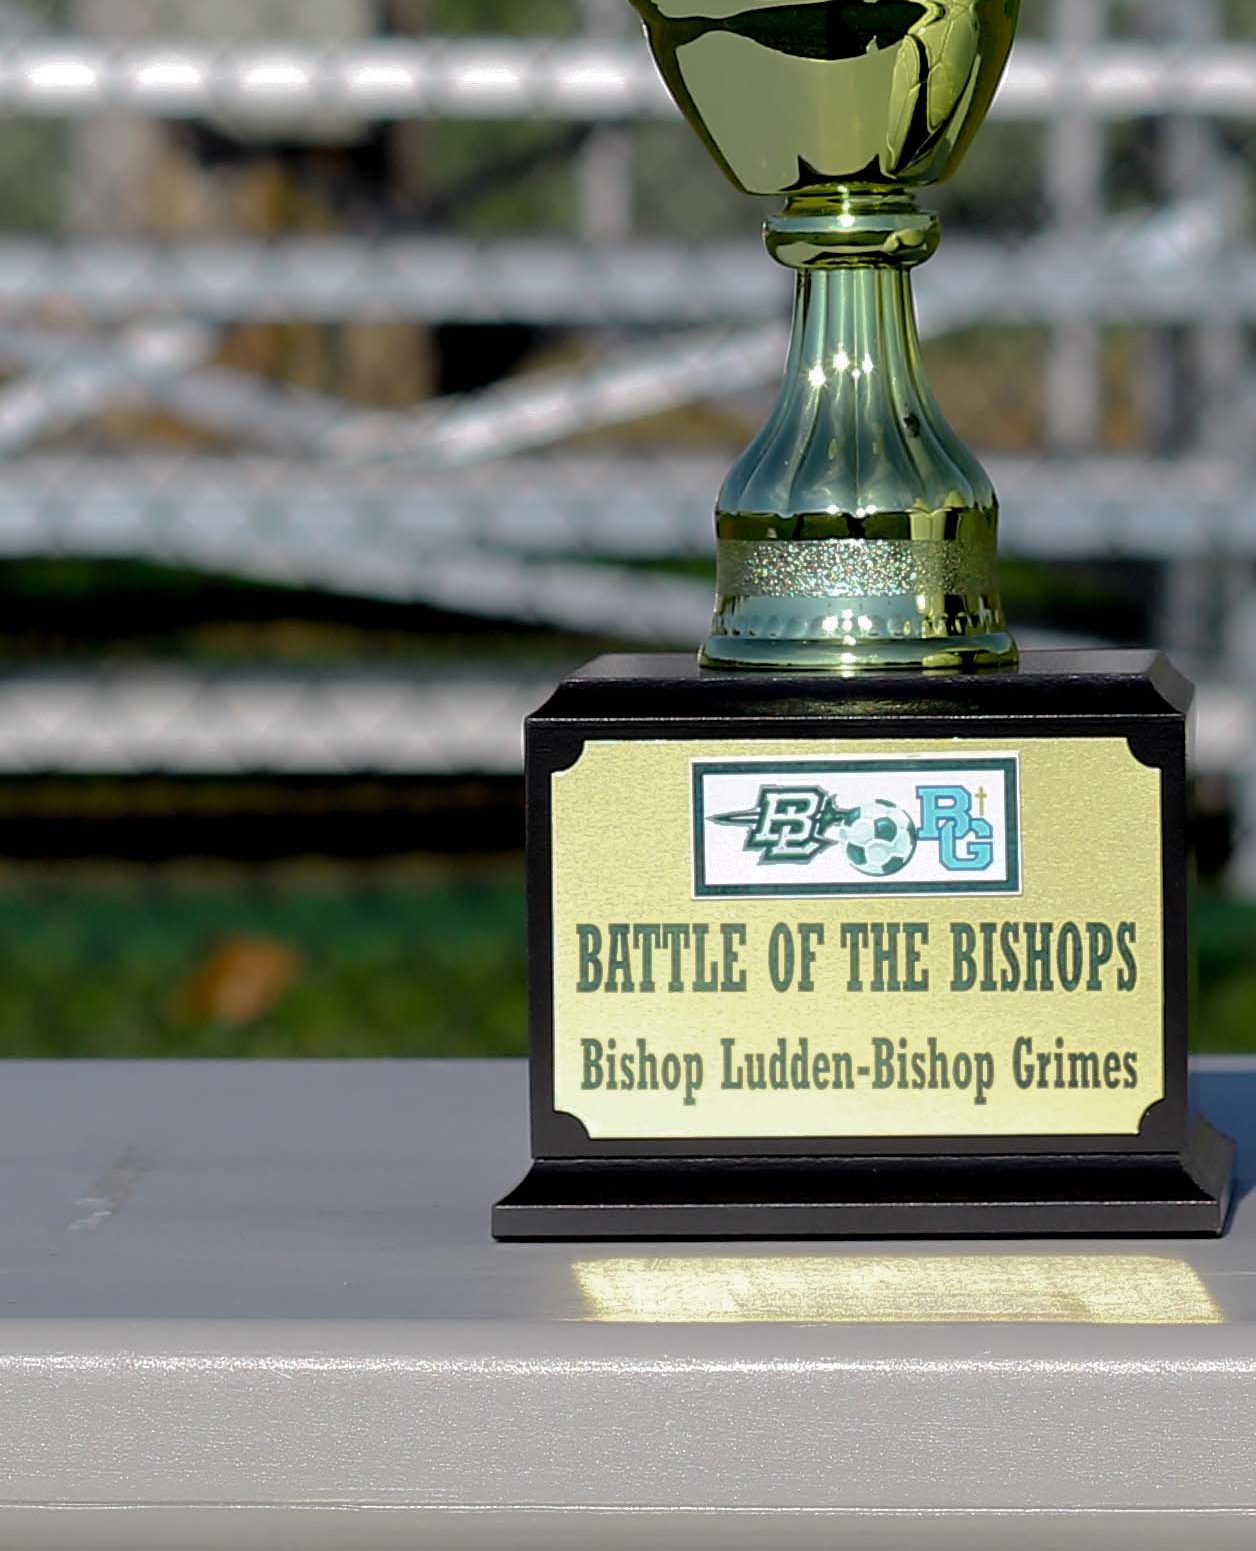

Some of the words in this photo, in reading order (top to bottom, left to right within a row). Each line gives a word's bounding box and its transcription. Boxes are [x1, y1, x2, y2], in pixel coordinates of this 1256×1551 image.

[576, 923, 748, 993] BATTLE
[768, 922, 824, 992] OF
[840, 922, 929, 992] THE
[949, 921, 1137, 992] BISHOPS
[580, 1038, 704, 1106] Bishop
[720, 1037, 994, 1105] Ludden-Bishop
[1012, 1036, 1138, 1090] Grimes
